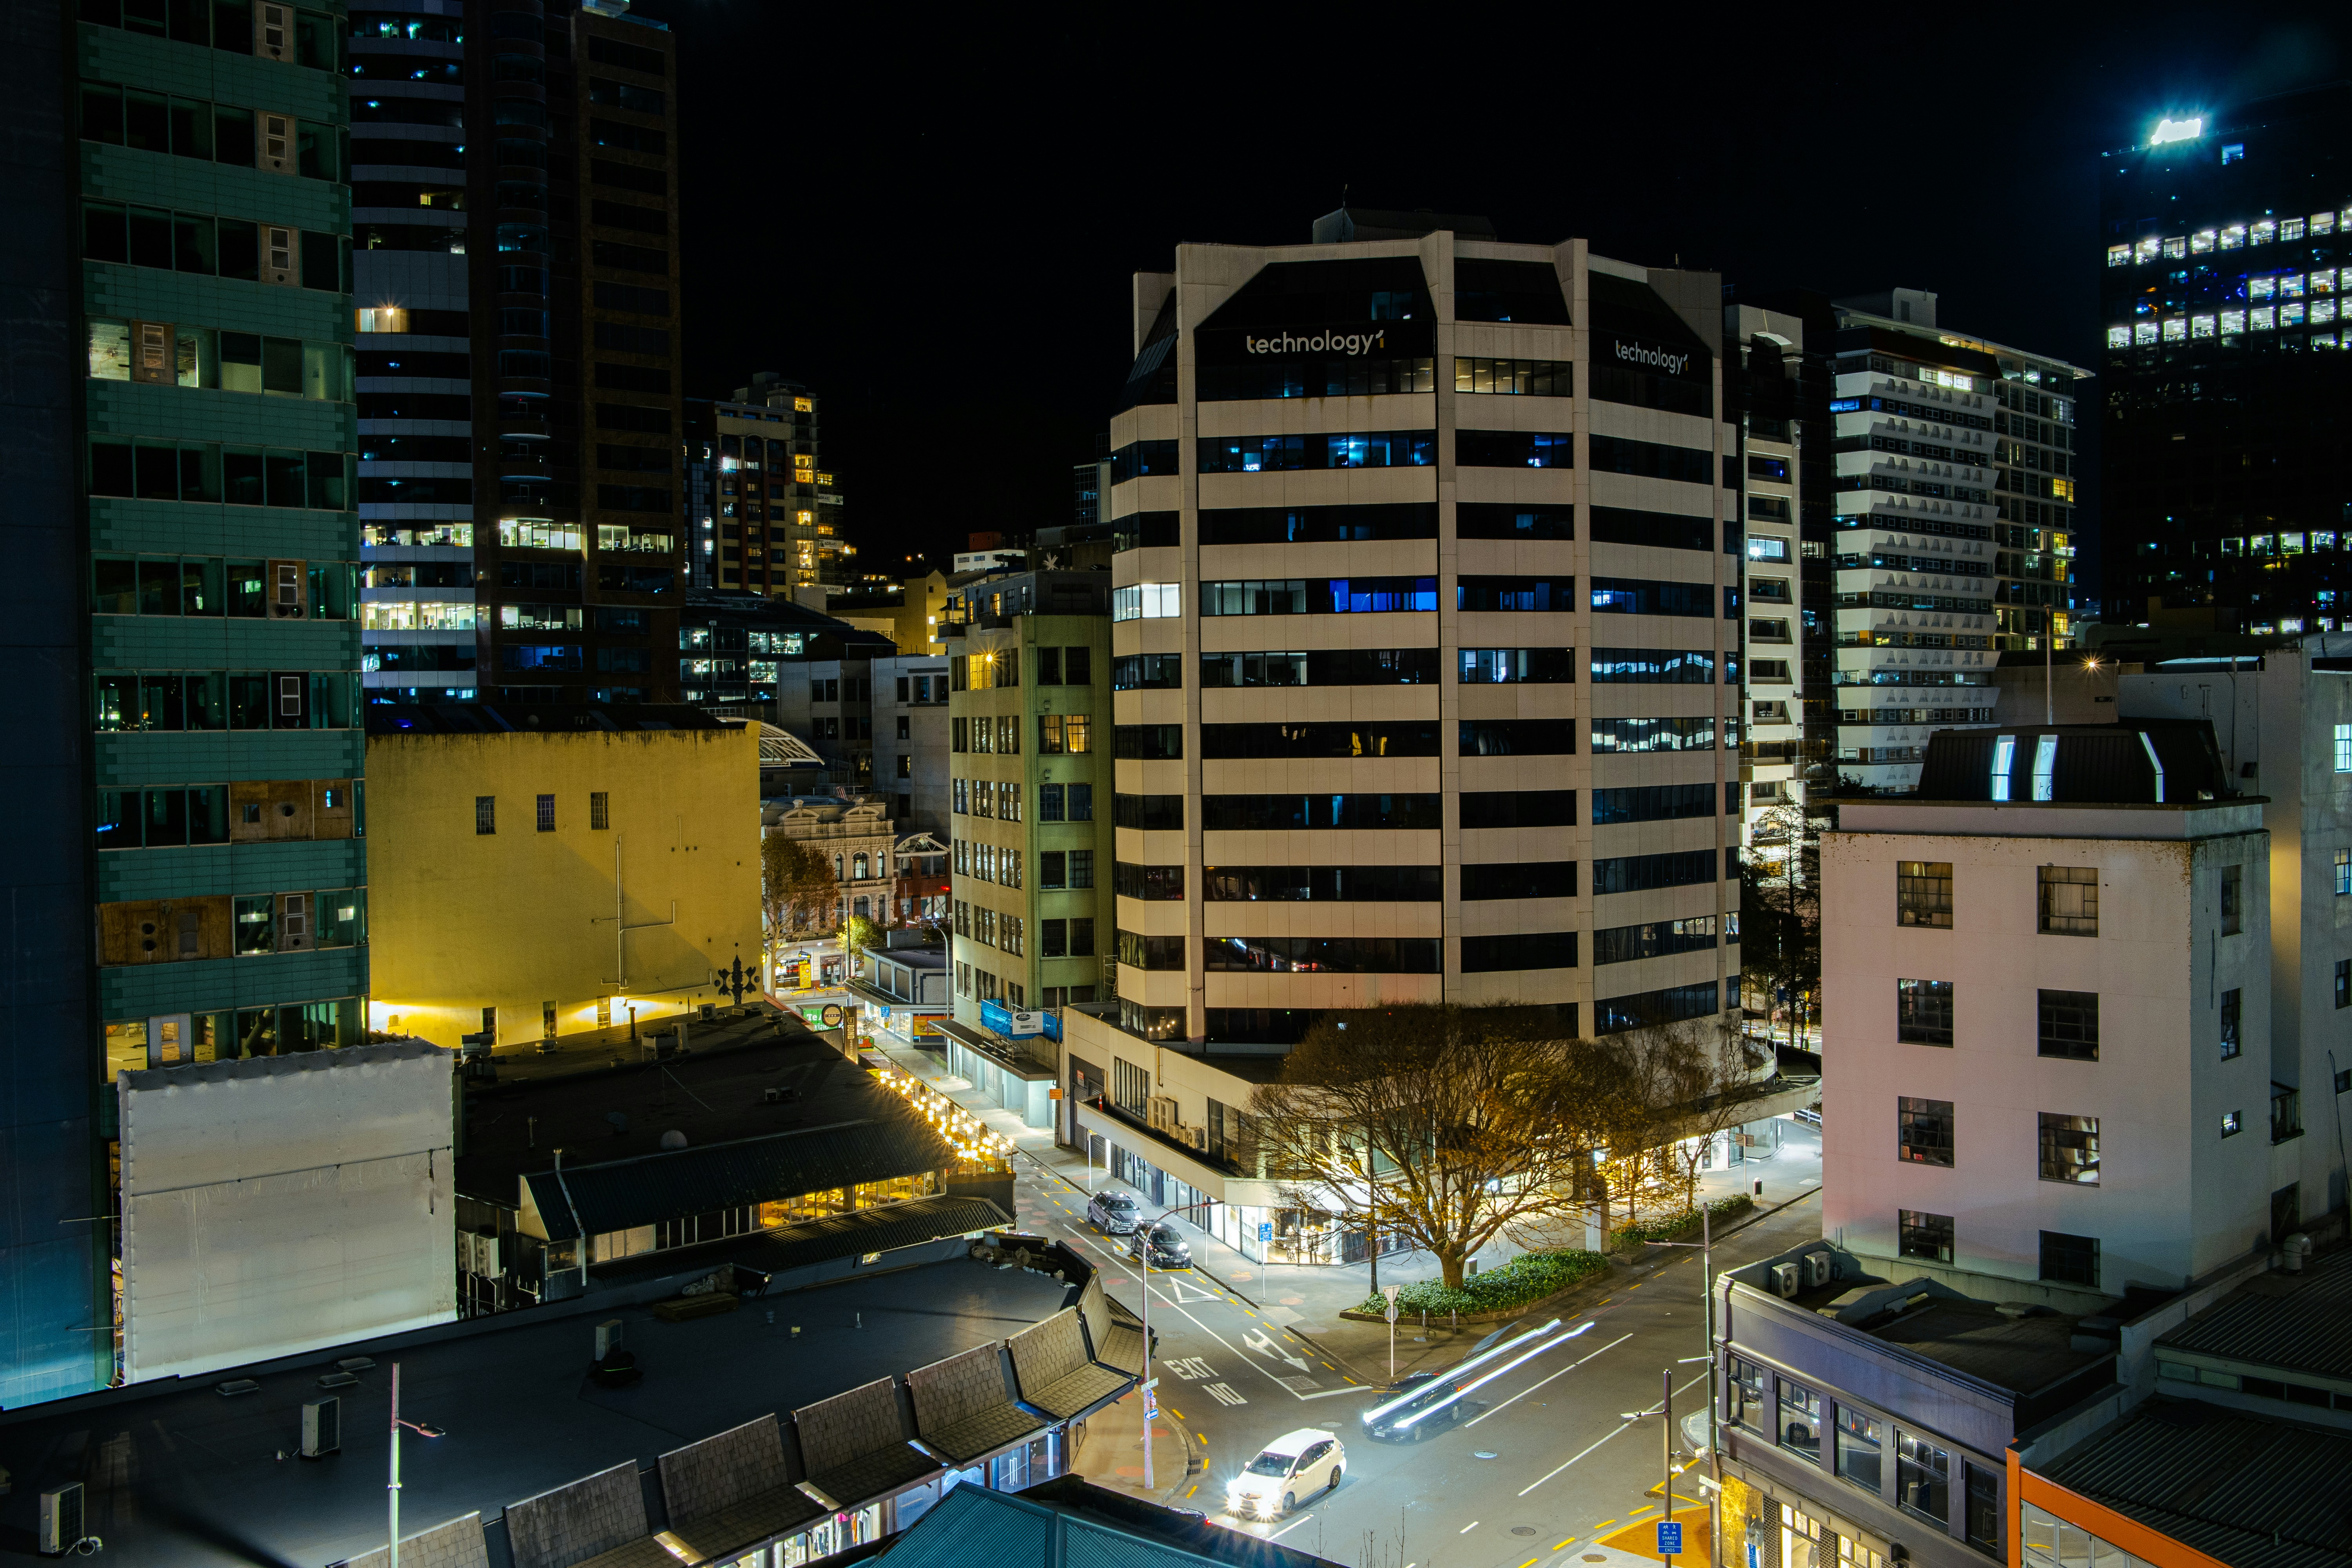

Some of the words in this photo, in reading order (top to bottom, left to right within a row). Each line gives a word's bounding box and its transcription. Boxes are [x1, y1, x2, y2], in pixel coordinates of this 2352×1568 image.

[1163, 1357, 1220, 1380] EXIT
[1201, 1382, 1248, 1406] NO
[1702, 1477, 1712, 1486] BOND
